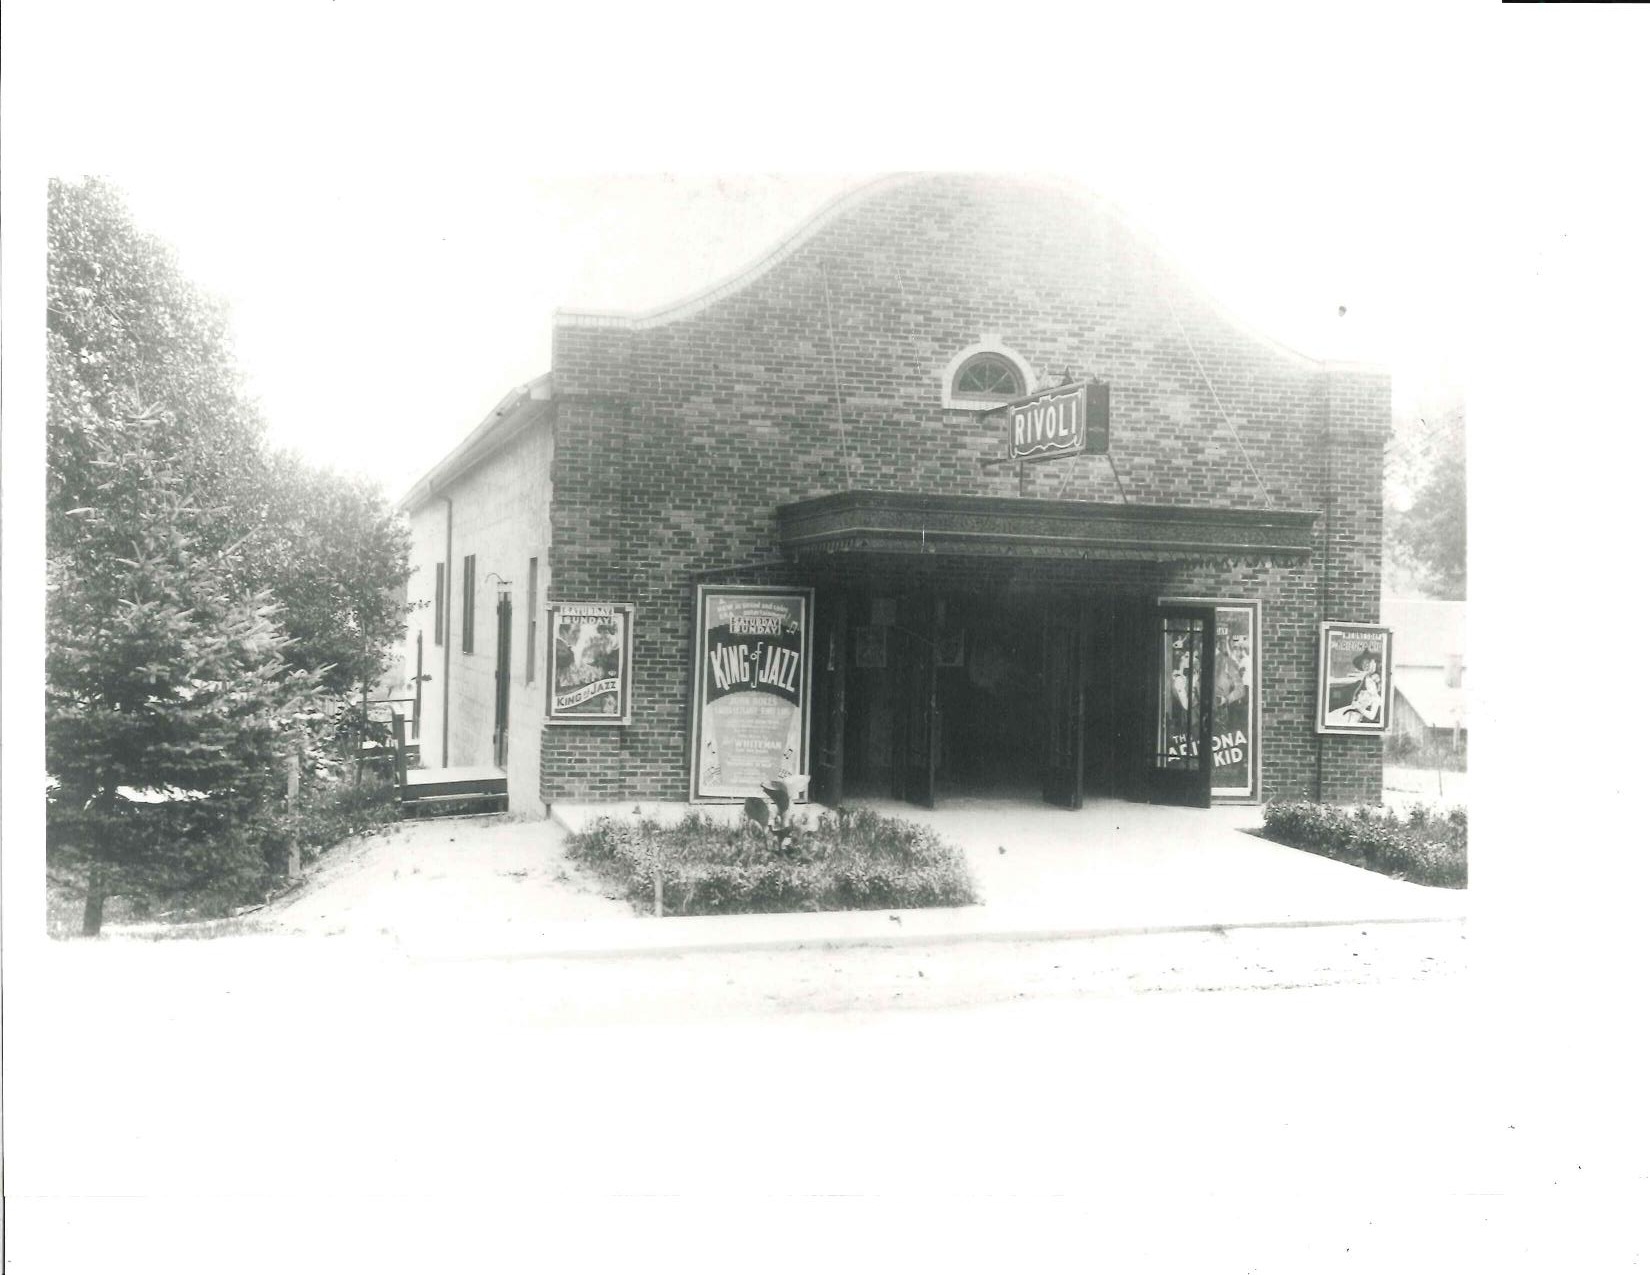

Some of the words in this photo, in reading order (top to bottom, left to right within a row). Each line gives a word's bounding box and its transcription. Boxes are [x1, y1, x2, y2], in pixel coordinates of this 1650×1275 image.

[1015, 401, 1076, 446] RIVOLI
[562, 606, 612, 615] SATURDAY
[562, 616, 612, 625] SUNDAY
[733, 617, 778, 626] SATURDAY
[733, 626, 778, 634] SUNDAY
[710, 643, 749, 691] KING
[750, 642, 764, 688] of
[759, 646, 800, 692] JAZZ
[557, 693, 582, 706] KING
[590, 681, 616, 695] JAZZ
[735, 739, 782, 750] WHITEMAN
[1168, 731, 1247, 762] ARIONA
[1213, 748, 1243, 767] KID
